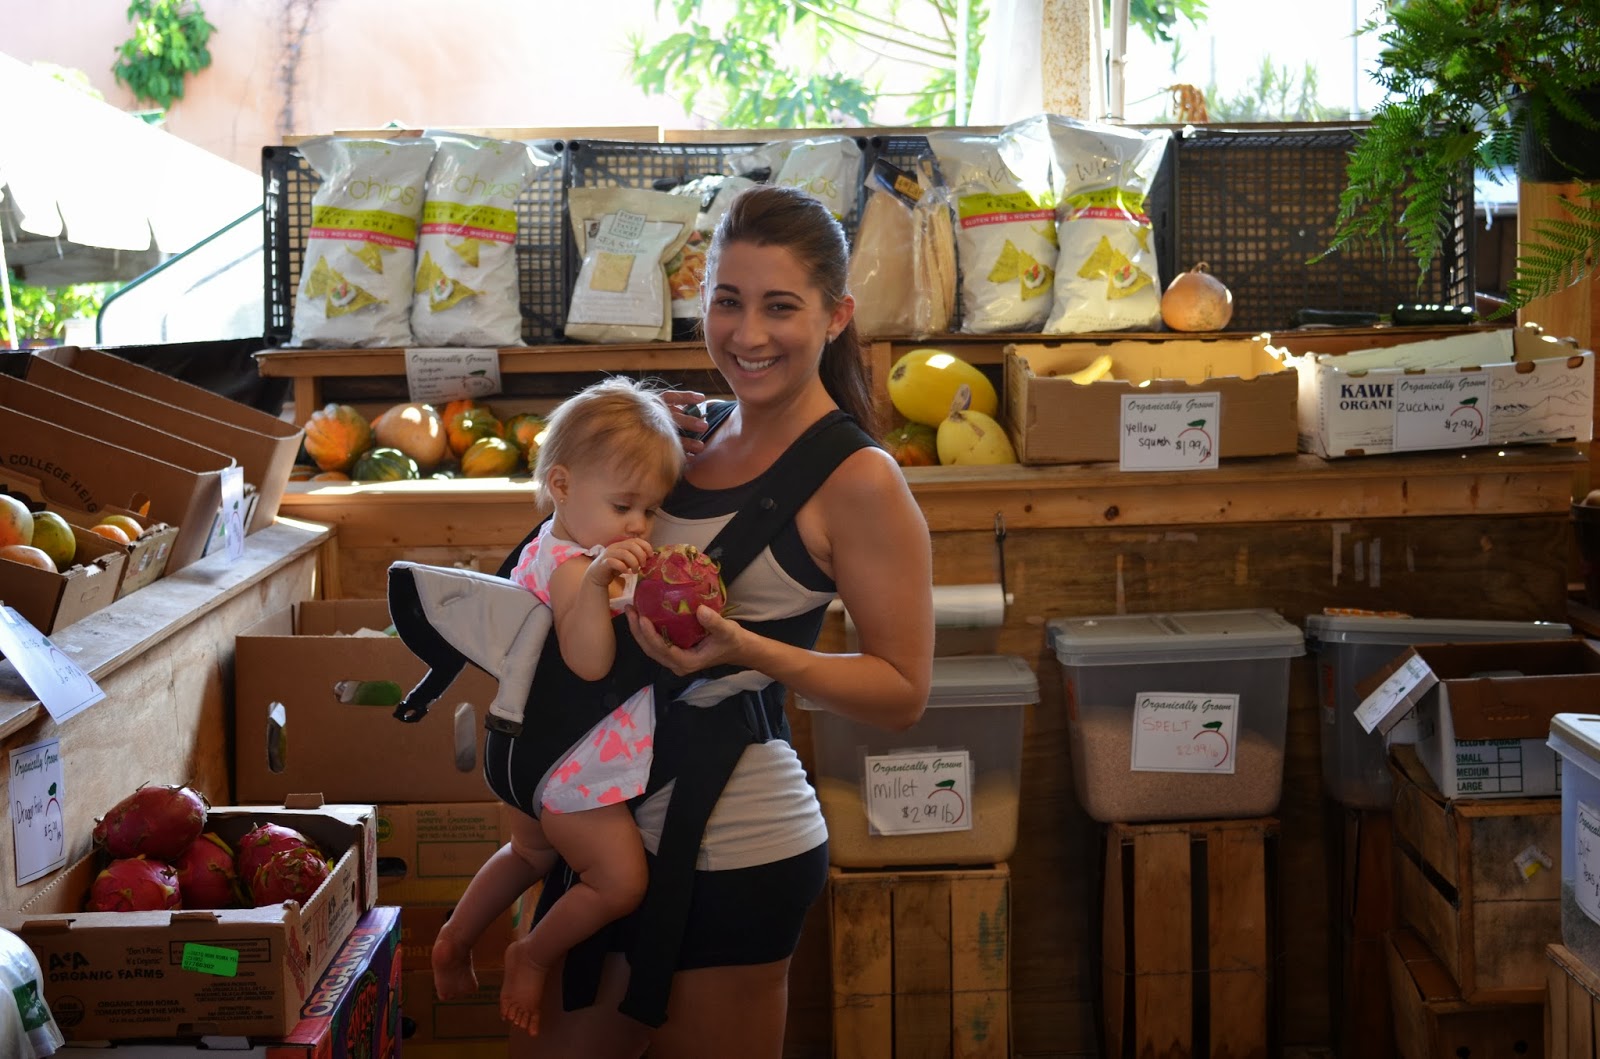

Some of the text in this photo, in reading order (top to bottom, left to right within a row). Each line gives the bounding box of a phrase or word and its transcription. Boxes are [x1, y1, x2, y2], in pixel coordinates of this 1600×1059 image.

[351, 175, 416, 206] chips
[453, 172, 519, 199] chips
[411, 353, 492, 366] Organically Grown
[1400, 377, 1487, 394] Organically Grown
[1127, 398, 1215, 413] Organically Grown
[1339, 400, 1392, 411] ORGANI
[9, 454, 98, 514] COLLEGE HEIG
[1141, 697, 1232, 714] Organically Grown
[1456, 753, 1483, 763] SMALL
[872, 758, 963, 776] Organically Grown
[1456, 766, 1489, 777] MEDIUM
[1457, 781, 1483, 791] LARGE
[48, 968, 165, 982] ORGANIC FARMS
[302, 933, 376, 1018] ORGANIC
[97, 1000, 134, 1008] ORGANIC
[94, 1008, 137, 1016] TOMATOES
